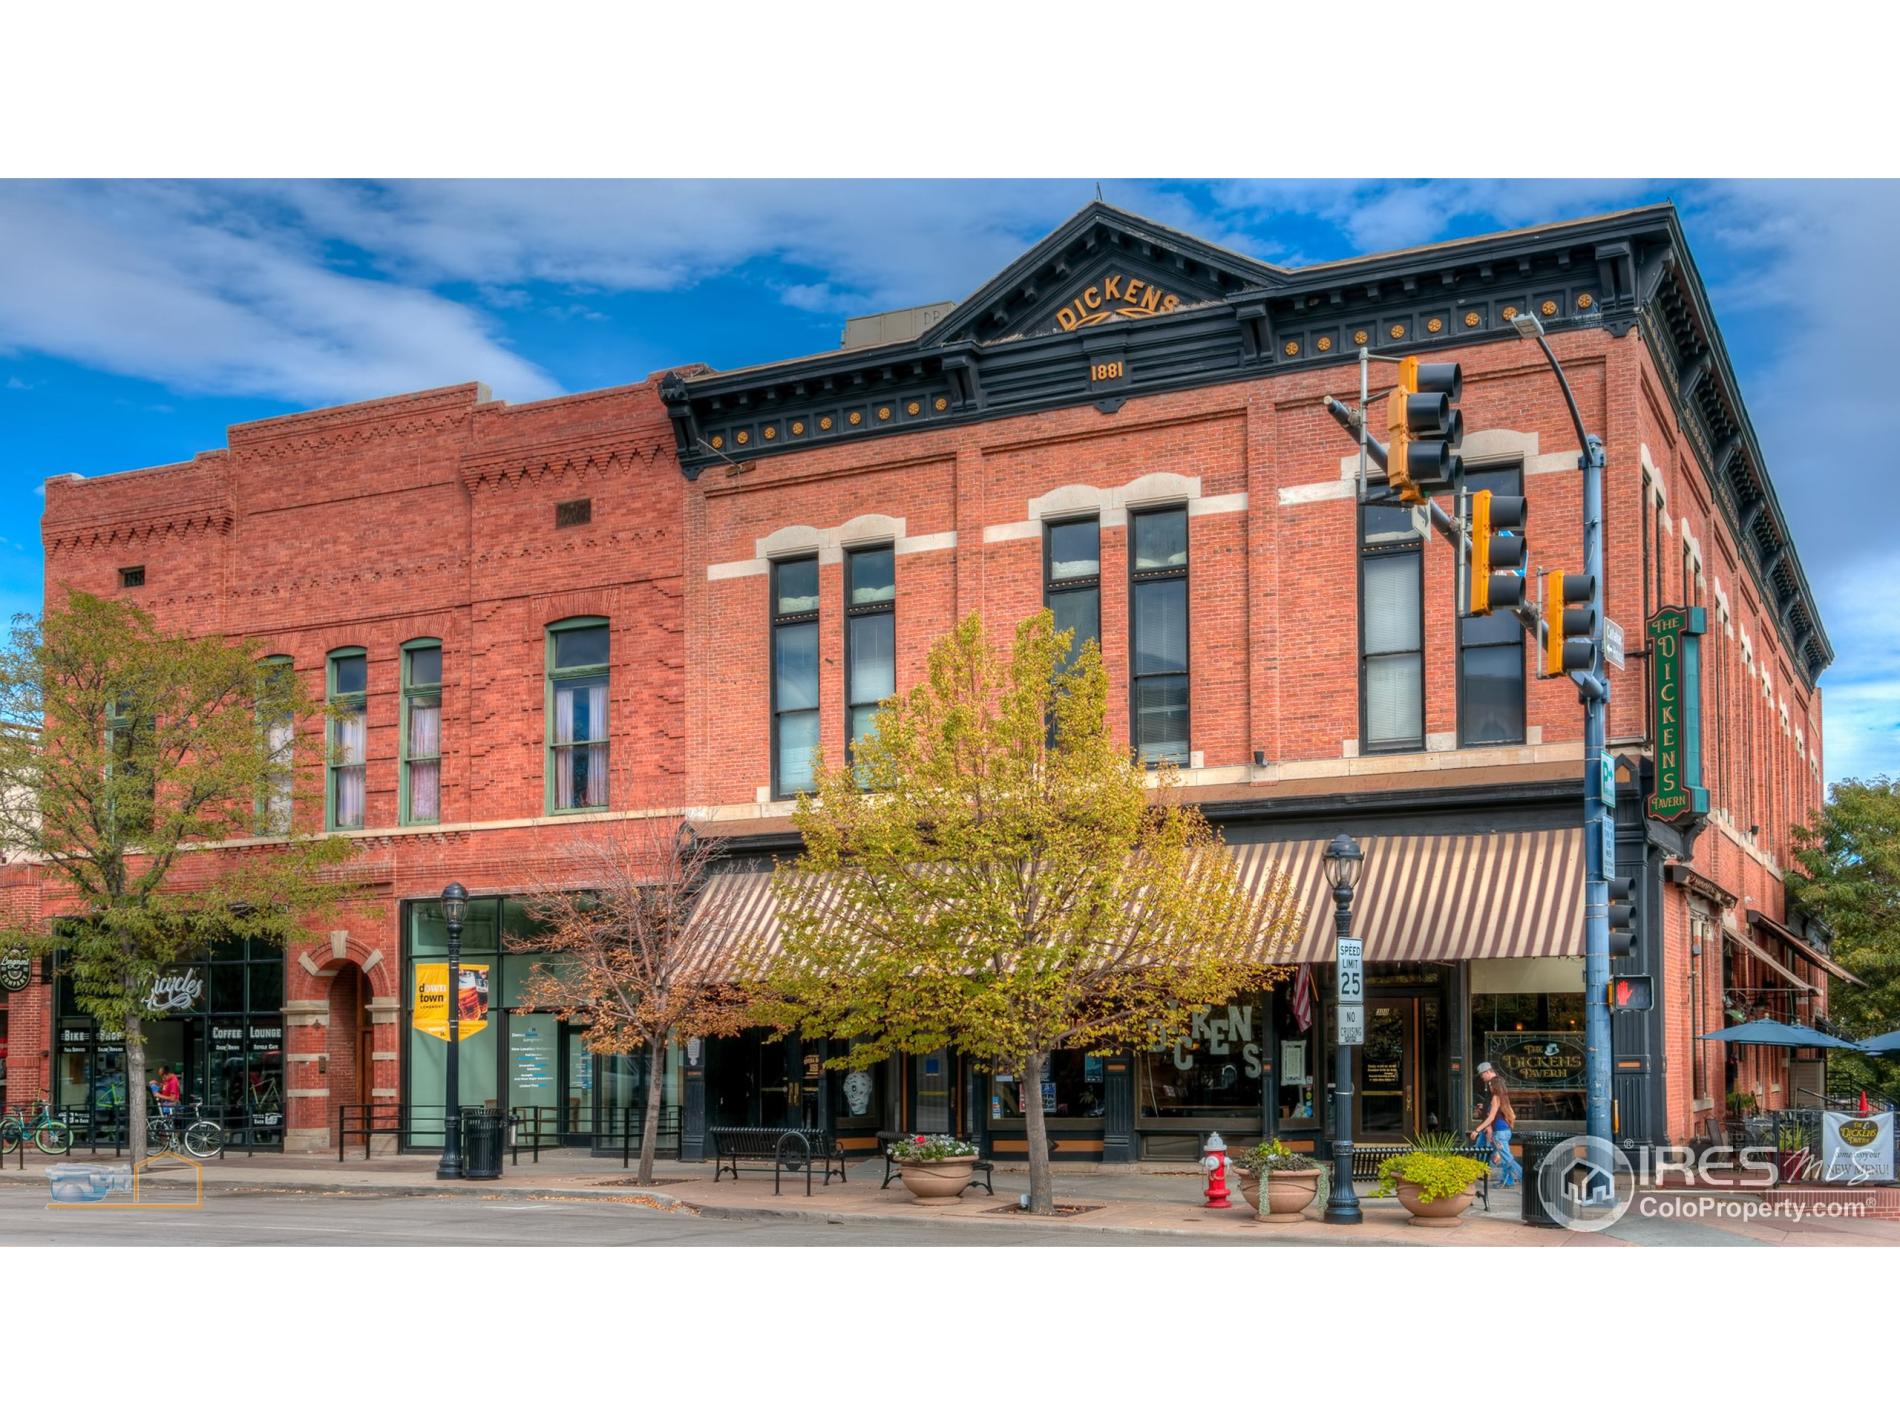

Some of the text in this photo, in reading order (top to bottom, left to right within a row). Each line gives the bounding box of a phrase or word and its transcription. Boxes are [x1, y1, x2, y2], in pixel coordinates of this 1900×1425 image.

[1056, 275, 1180, 331] DICKENS
[1091, 361, 1123, 381] 1881
[1652, 617, 1680, 633] THE
[1657, 635, 1676, 791] DICKENS
[1651, 795, 1686, 810] TAVERN
[1340, 946, 1361, 956] SPEED
[1342, 960, 1358, 968] LIMIT
[141, 967, 204, 1011] icycles
[419, 983, 447, 993] down
[1341, 972, 1361, 995] 25
[420, 994, 444, 1003] town
[1346, 1012, 1356, 1022] NO
[64, 1030, 84, 1041] BIKE
[213, 1026, 281, 1038] COFFEE LOUNGE
[1146, 1000, 1261, 1078] DCKENS
[1524, 1044, 1543, 1054] THE
[1502, 1055, 1582, 1069] DICKENS
[1519, 1068, 1568, 1079] TAVERN
[1840, 1127, 1877, 1137] DICKENS
